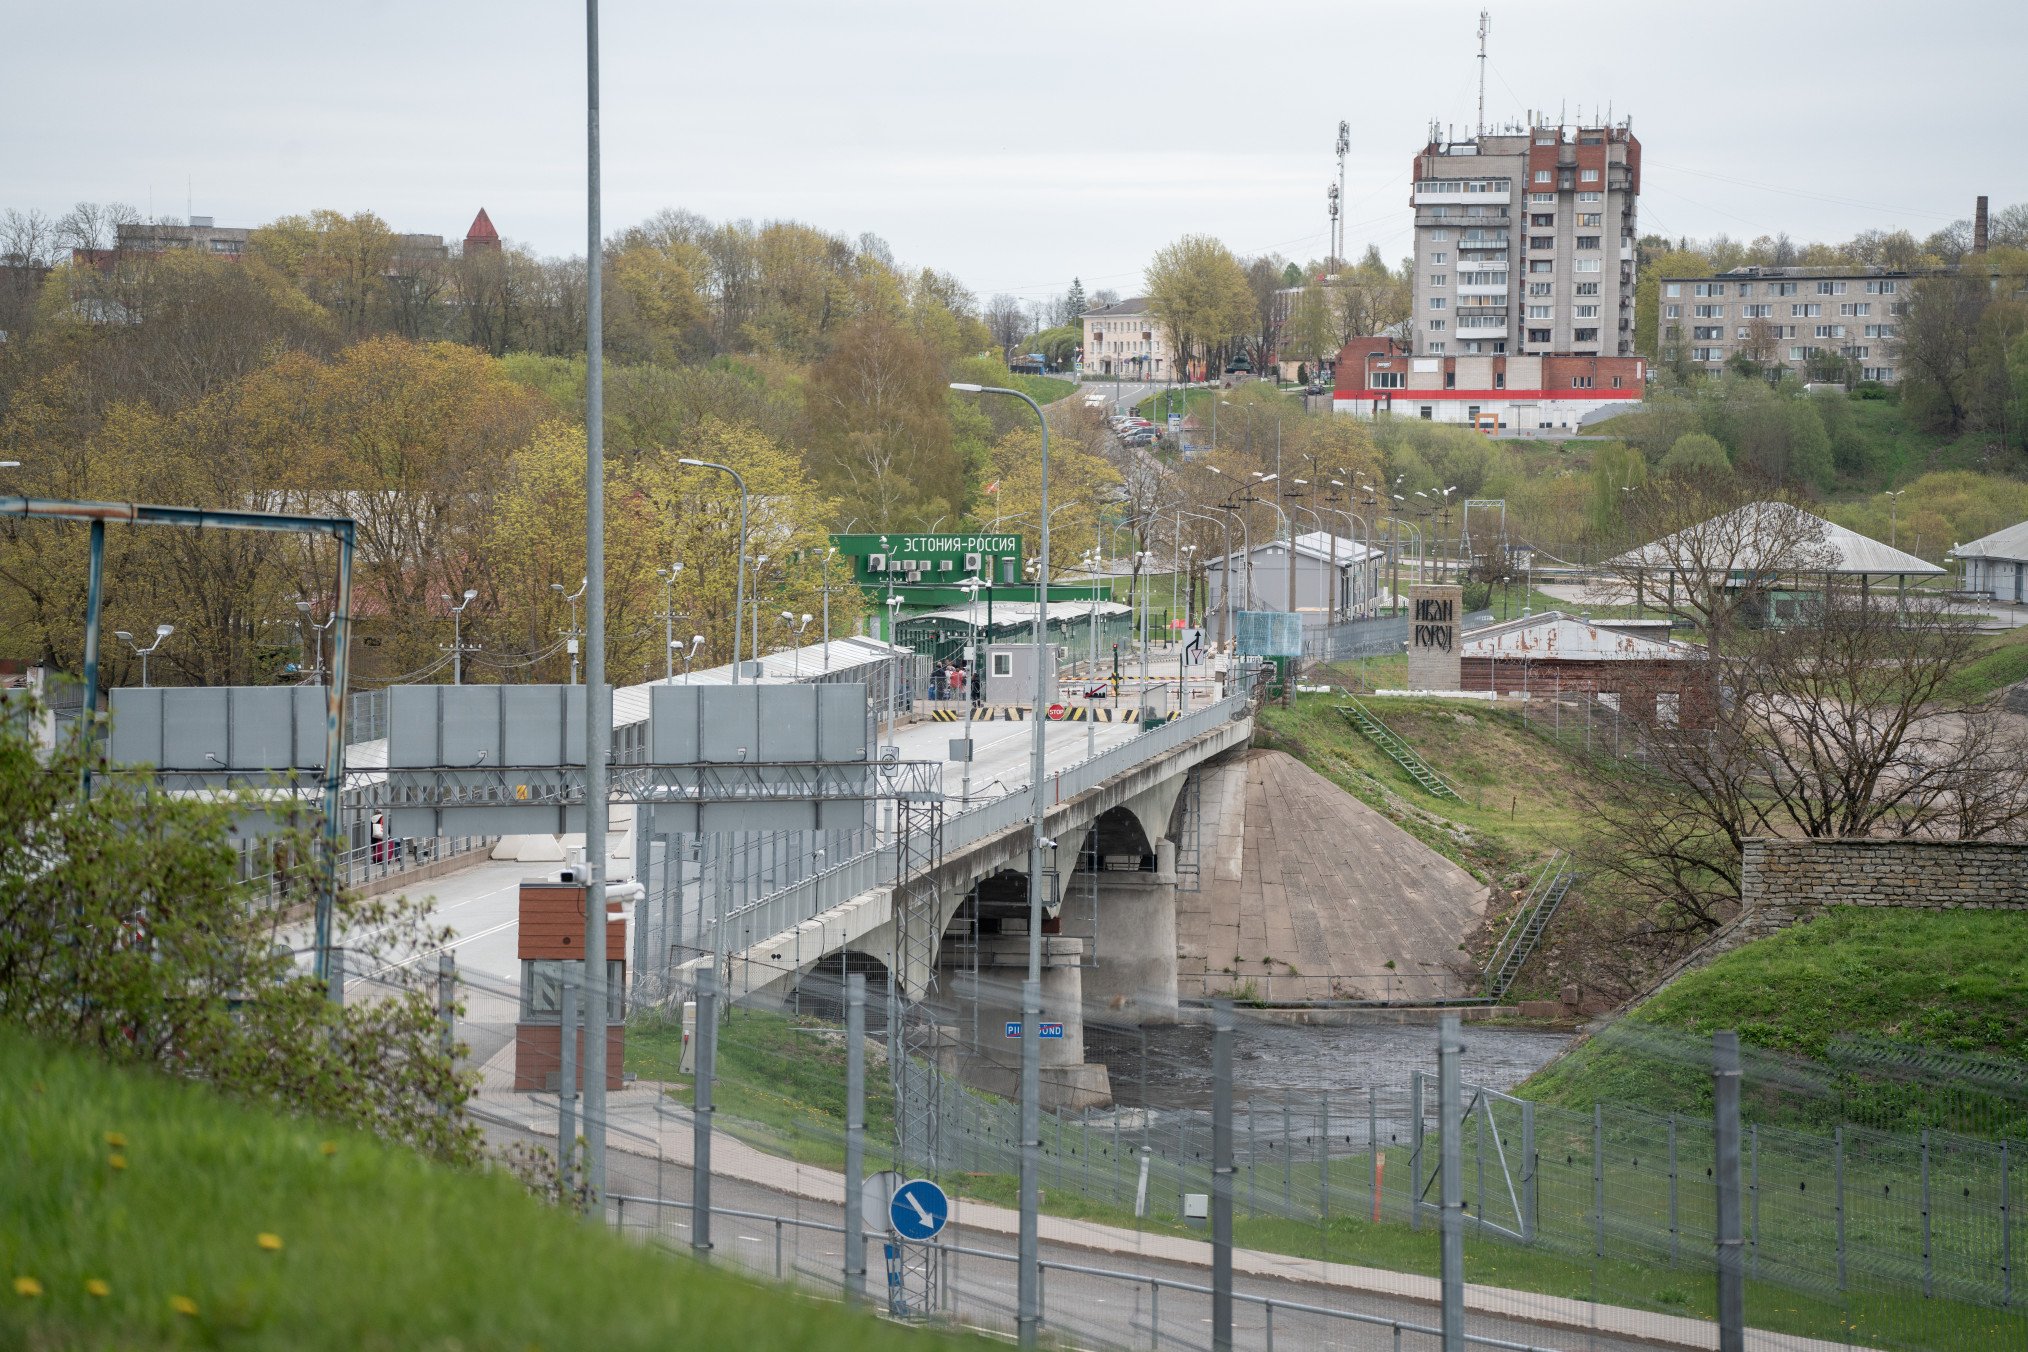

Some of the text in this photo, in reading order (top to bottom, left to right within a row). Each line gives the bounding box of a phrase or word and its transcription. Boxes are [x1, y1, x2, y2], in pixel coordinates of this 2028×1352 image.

[904, 537, 1016, 552] ЭСТОНИЯ-РОССИЯ
[1415, 598, 1453, 622] ИВАН
[1415, 624, 1453, 654] ГОРОД
